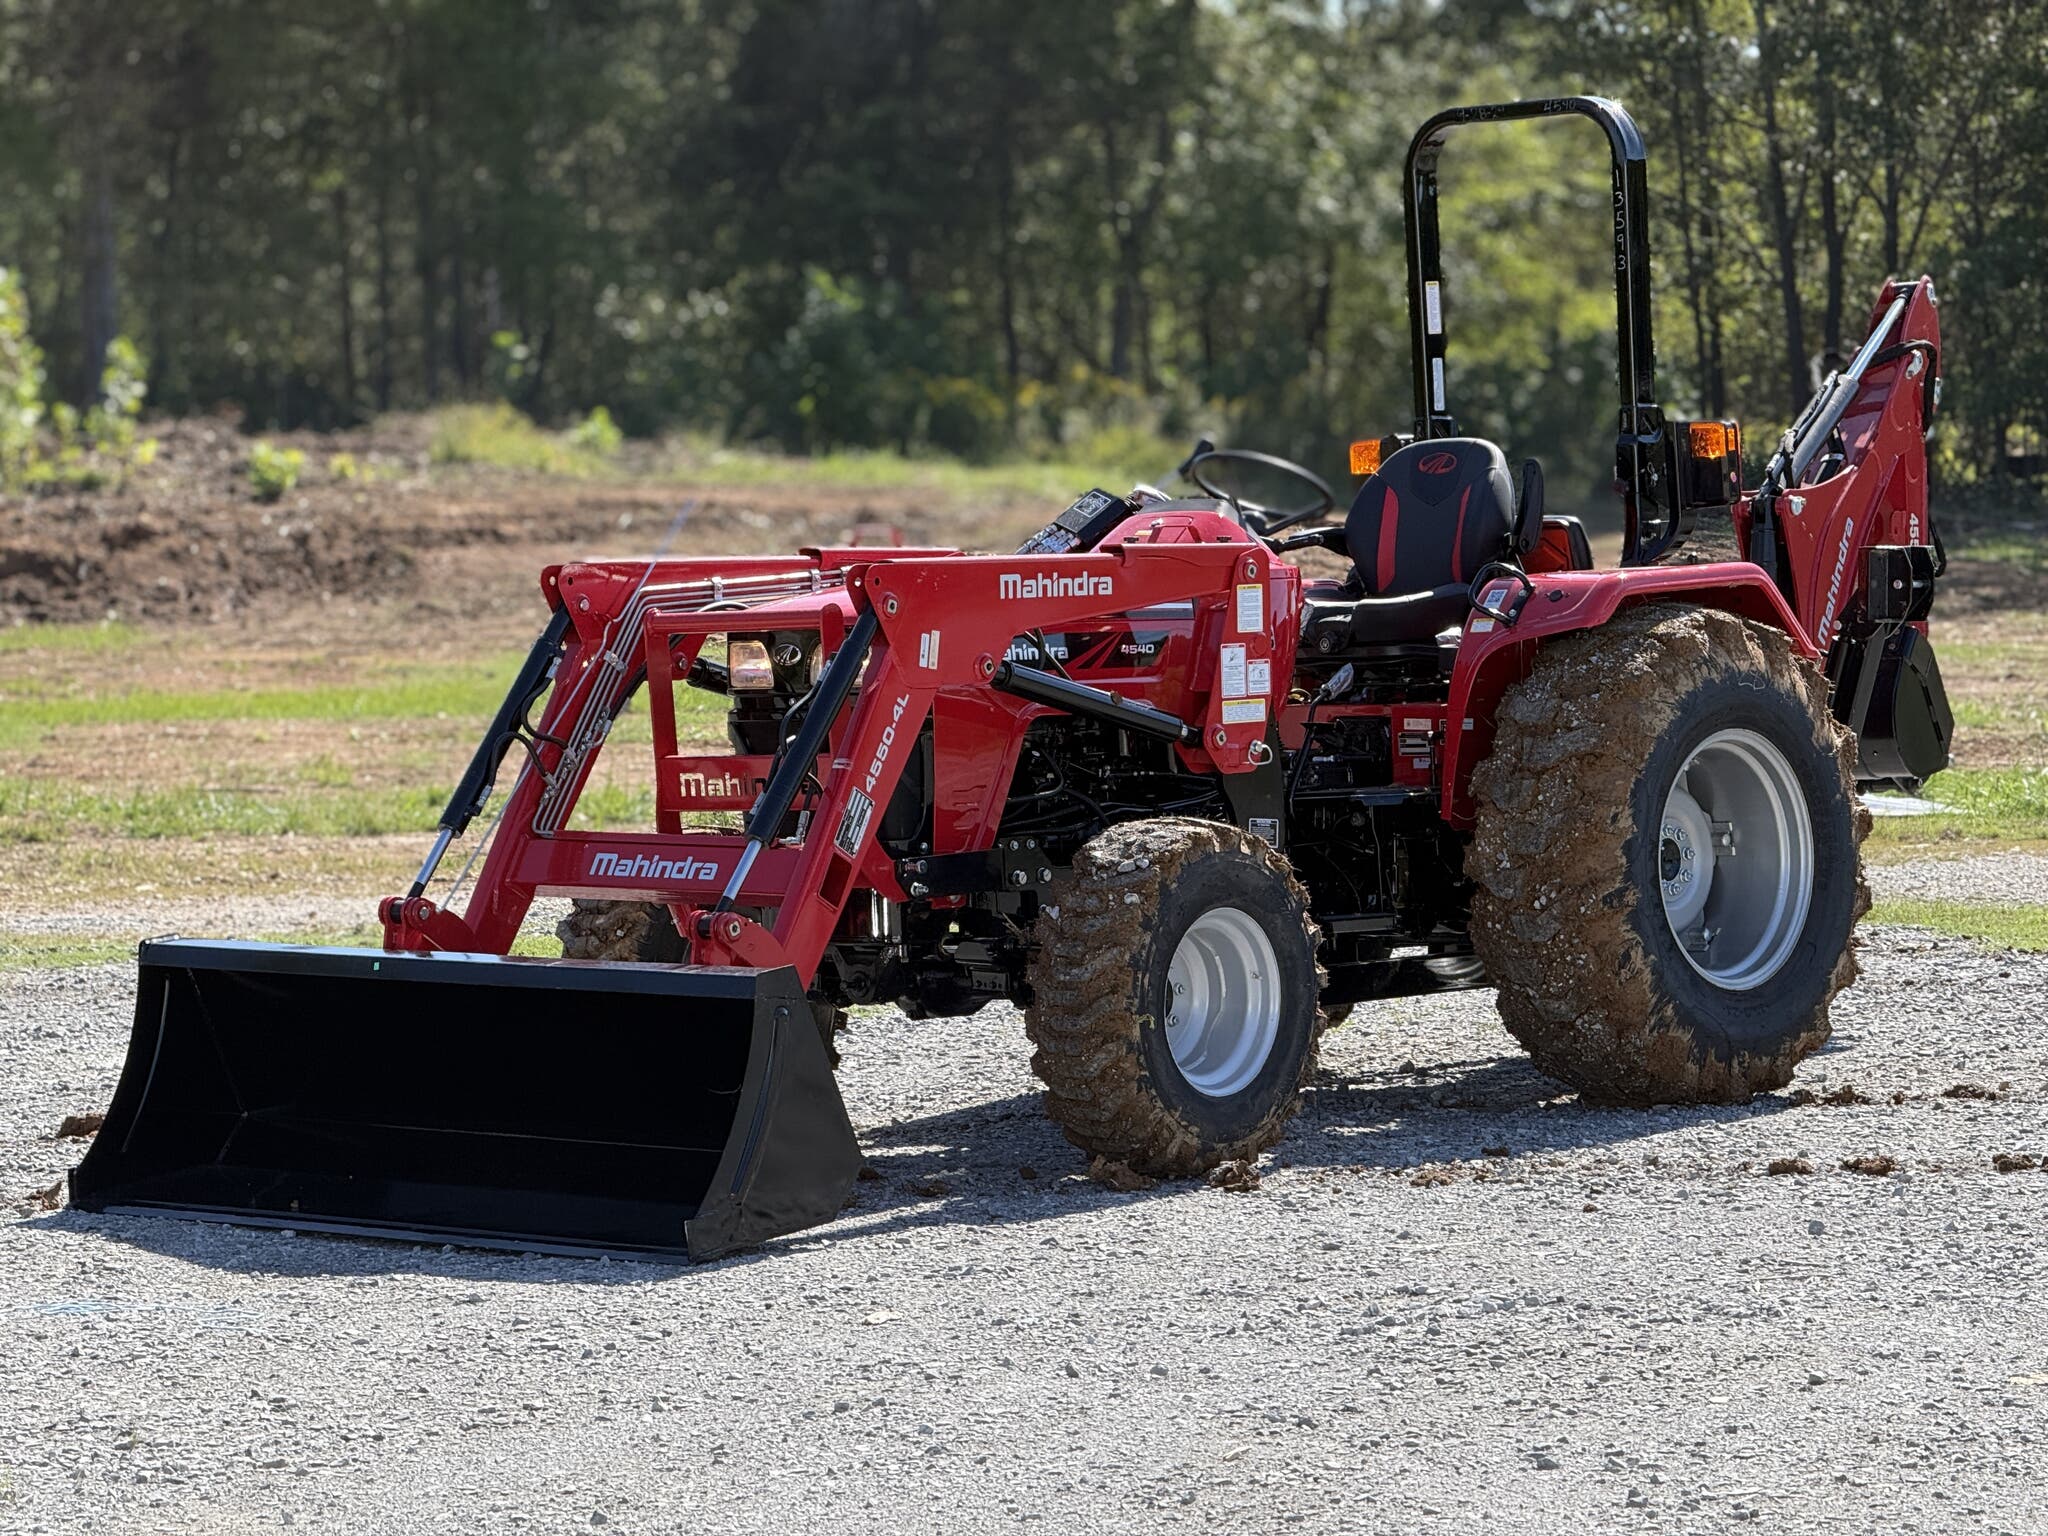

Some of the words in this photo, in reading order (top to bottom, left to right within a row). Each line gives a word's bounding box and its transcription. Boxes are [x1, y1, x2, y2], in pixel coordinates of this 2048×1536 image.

[1613, 168, 1627, 271] 13593
[1000, 571, 1113, 600] Mahindra
[1818, 517, 1854, 646] Mahindra
[1002, 643, 1069, 660] ahinra
[1121, 644, 1154, 654] 4540
[866, 694, 910, 793] 4550-4L
[589, 853, 718, 881] Mahindra
